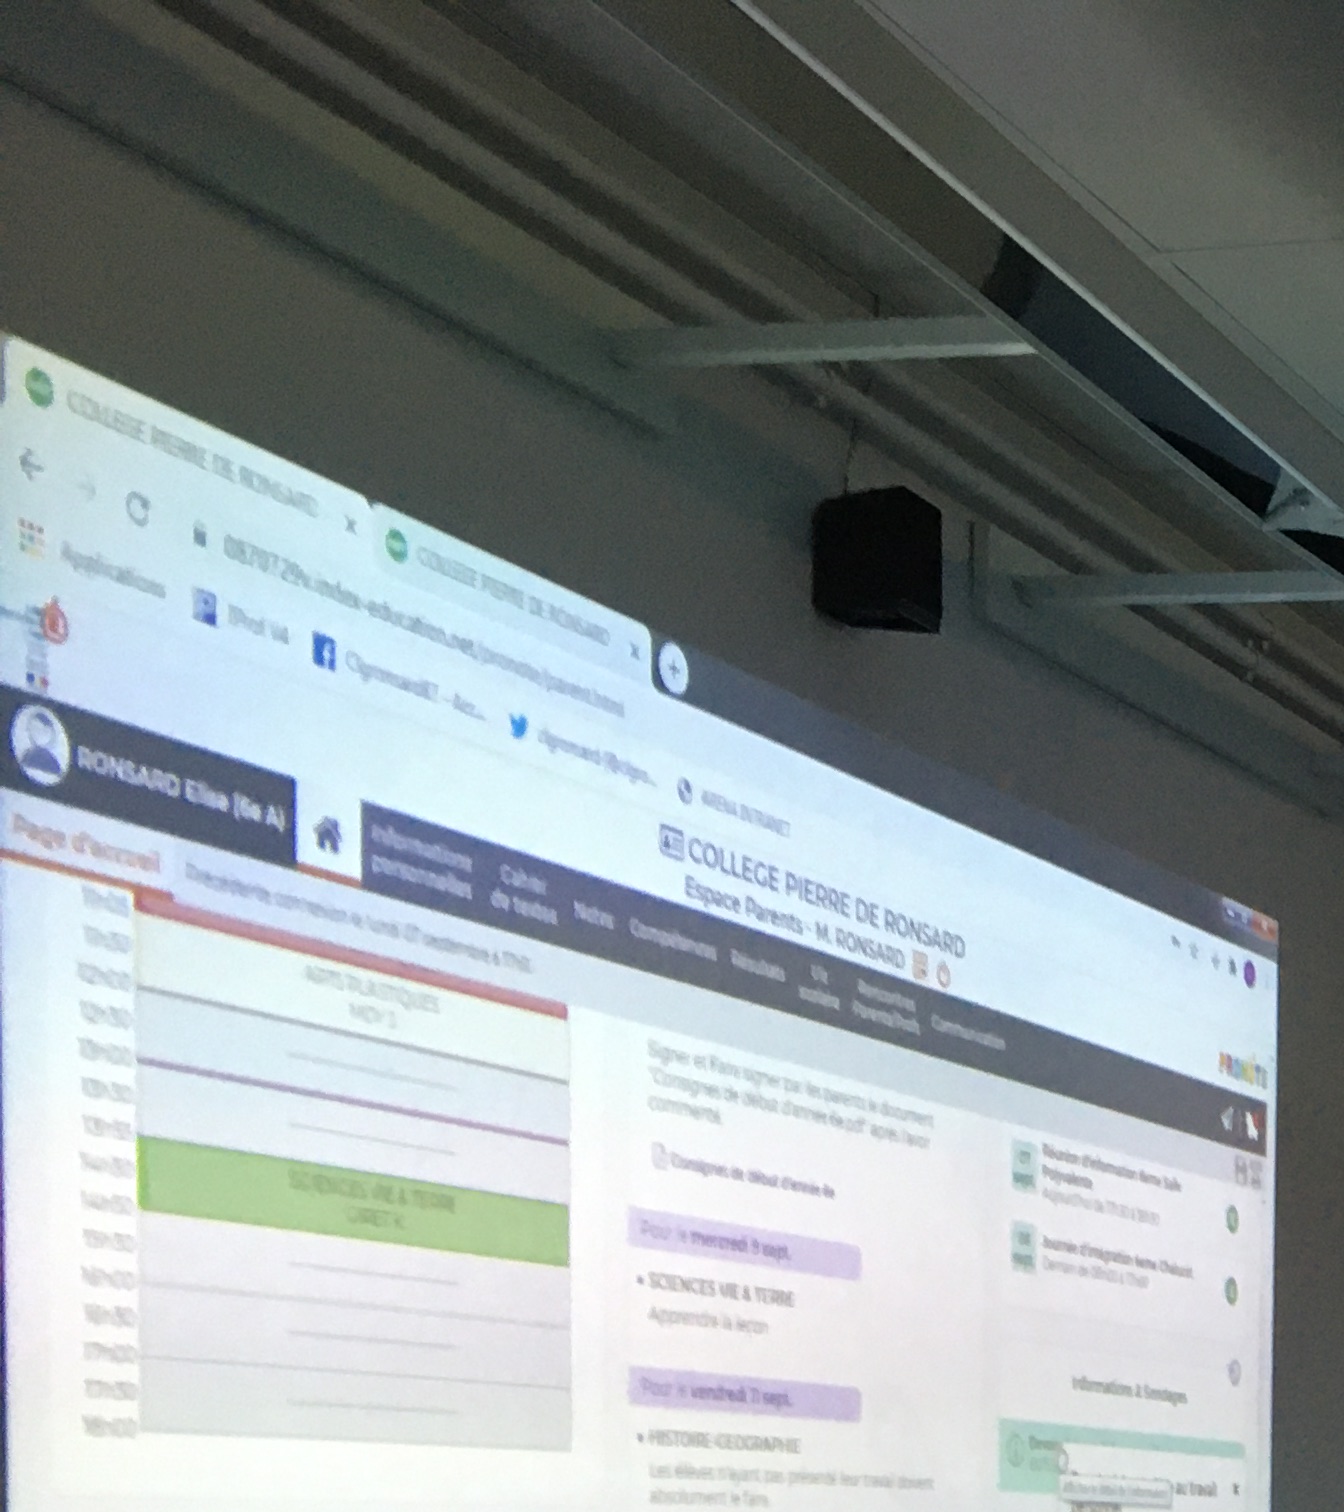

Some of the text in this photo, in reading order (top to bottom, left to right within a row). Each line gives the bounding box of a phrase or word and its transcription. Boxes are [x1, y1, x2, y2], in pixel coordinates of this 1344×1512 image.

[77, 746, 180, 801] RONSARD
[12, 811, 64, 850] Page
[689, 836, 965, 960] COLLEGE PIERRE DE RONSARD
[684, 875, 740, 917] Espace
[745, 896, 803, 938] Parents
[834, 927, 905, 972] RONSARD
[647, 1040, 689, 1069] Signer
[671, 1152, 726, 1181] Consignes
[690, 1229, 748, 1255] mercredi
[648, 1272, 716, 1298] SCIENCES
[719, 1283, 739, 1301] VIE
[754, 1288, 794, 1309] TERRE
[647, 1304, 718, 1331] Apprendre
[689, 1381, 747, 1404] vendredi
